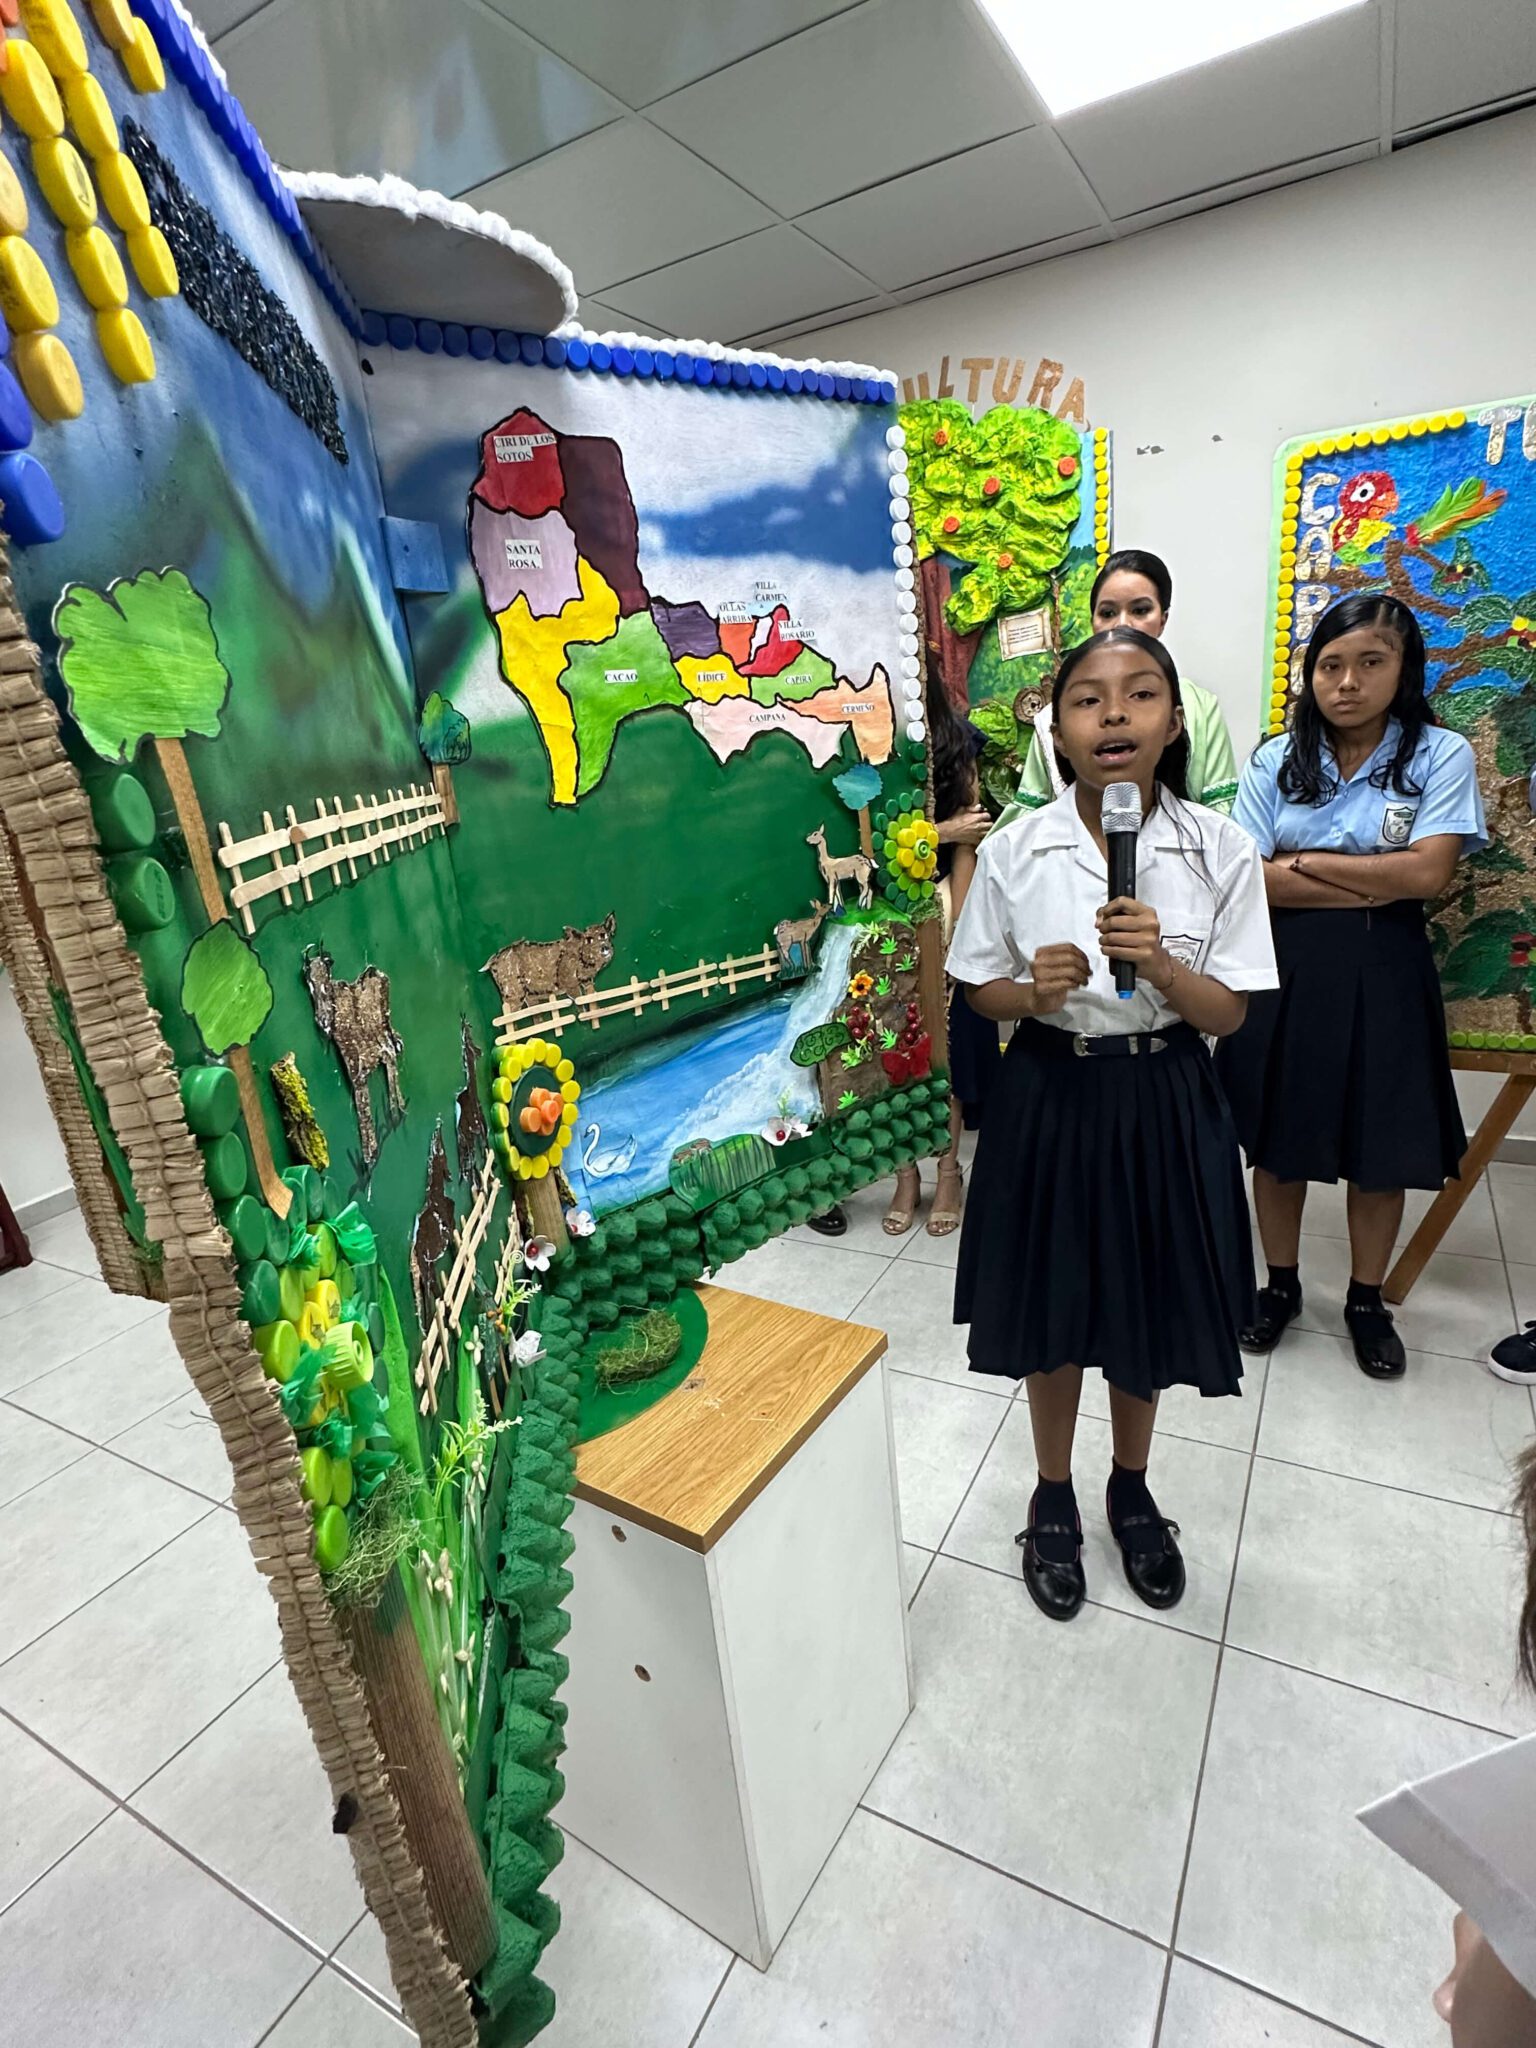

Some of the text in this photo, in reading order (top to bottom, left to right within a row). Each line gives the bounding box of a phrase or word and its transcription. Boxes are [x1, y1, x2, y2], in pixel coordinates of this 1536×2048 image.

[534, 433, 555, 445] LOS
[506, 544, 541, 554] SANTA
[509, 559, 540, 569] ROSA.
[755, 581, 777, 590] VILLA
[755, 593, 788, 602] CARMEN
[722, 614, 752, 624] ARRIBA
[778, 619, 802, 629] VILLA
[781, 630, 815, 640] ROSARIO
[605, 672, 638, 682] CACAO
[785, 675, 812, 685] CAPIRA
[841, 703, 875, 713] CERMEÑO
[749, 712, 786, 723] CAMPANA
